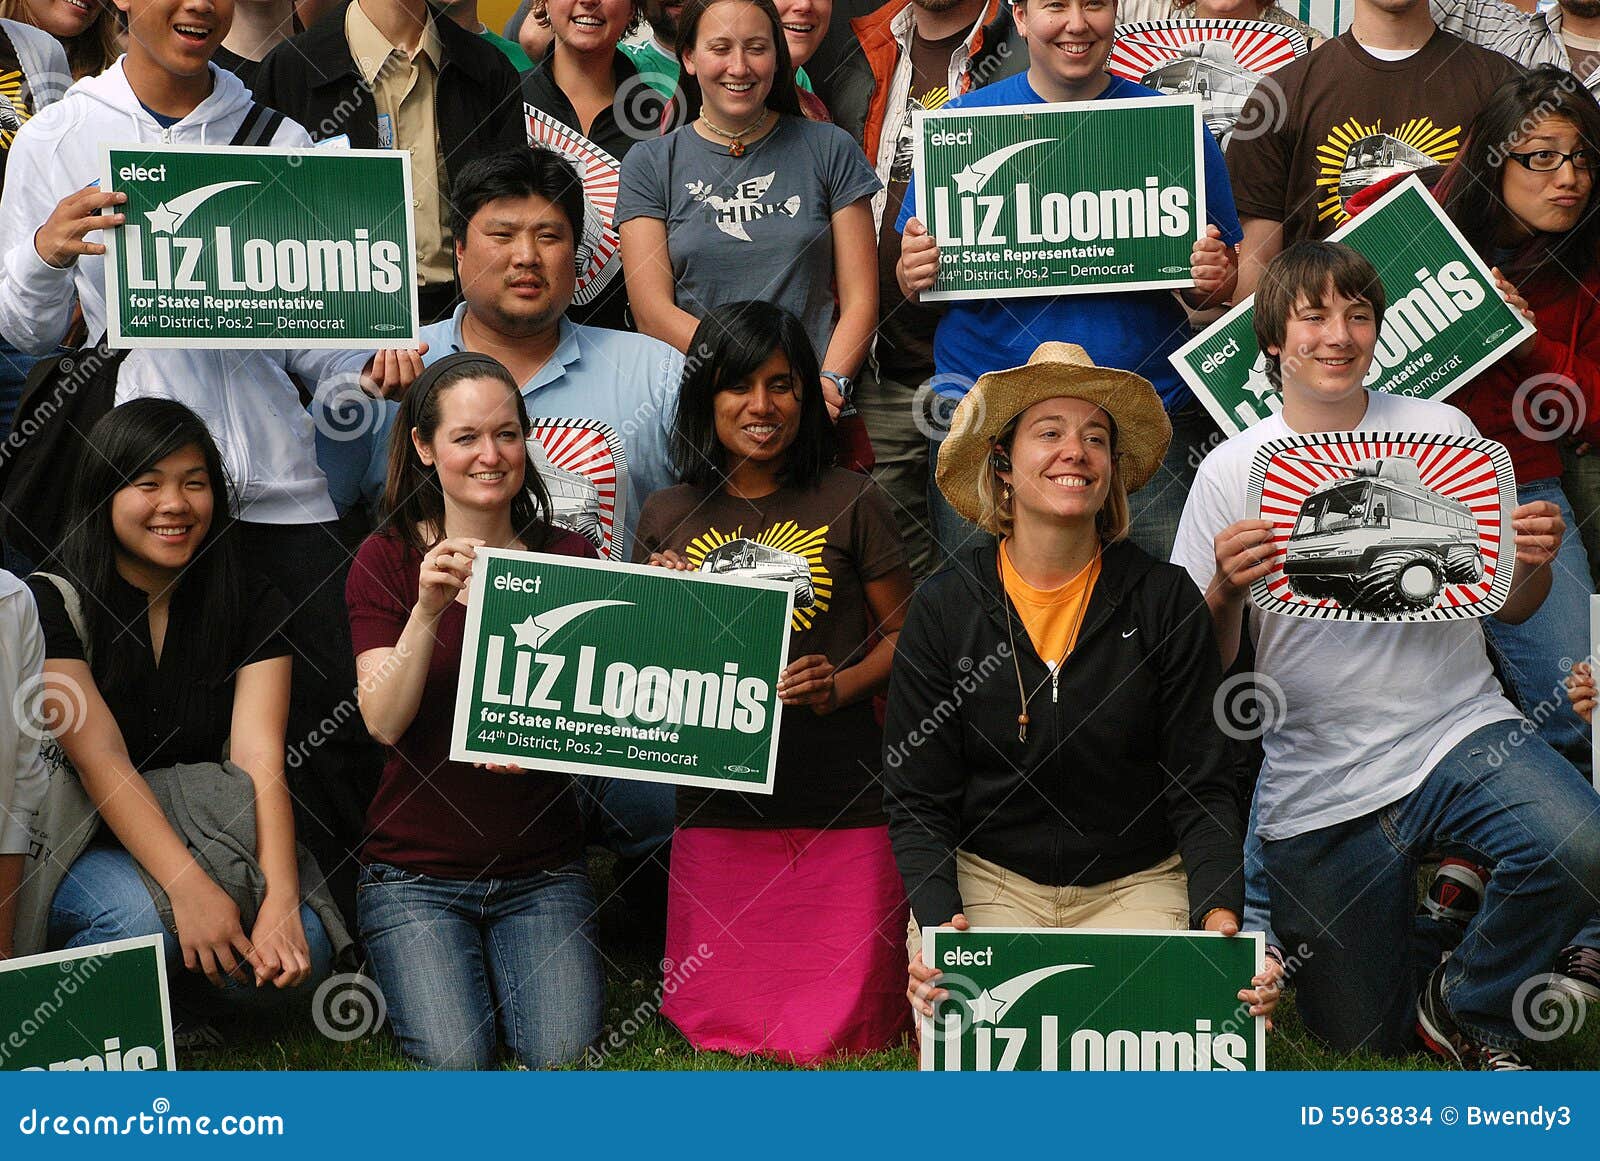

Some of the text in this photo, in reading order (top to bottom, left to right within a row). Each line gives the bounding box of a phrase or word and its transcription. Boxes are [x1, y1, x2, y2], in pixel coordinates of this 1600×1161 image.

[931, 127, 973, 146] elect
[119, 163, 166, 182] elect
[934, 176, 1190, 247] Liz Loomis
[125, 224, 402, 293] Liz Loomis
[938, 245, 1115, 264] for State Representative
[963, 268, 1013, 282] District,
[1070, 263, 1135, 277] Democrat
[129, 294, 324, 312] for State Representative
[130, 314, 158, 329] 44th
[159, 315, 214, 331] District,
[217, 316, 254, 329] Pos.2
[277, 316, 345, 330] Democrat
[1362, 260, 1486, 387] omis
[1201, 336, 1241, 374] elect
[1378, 352, 1434, 394] entative
[494, 571, 542, 595] elect
[481, 635, 769, 734] Liz Loomis
[480, 707, 680, 744] for State Representative
[478, 729, 506, 744] 44th
[507, 731, 562, 753] District,
[565, 738, 603, 756] Pos.2
[627, 745, 699, 767] Democrat
[943, 945, 993, 966] elect
